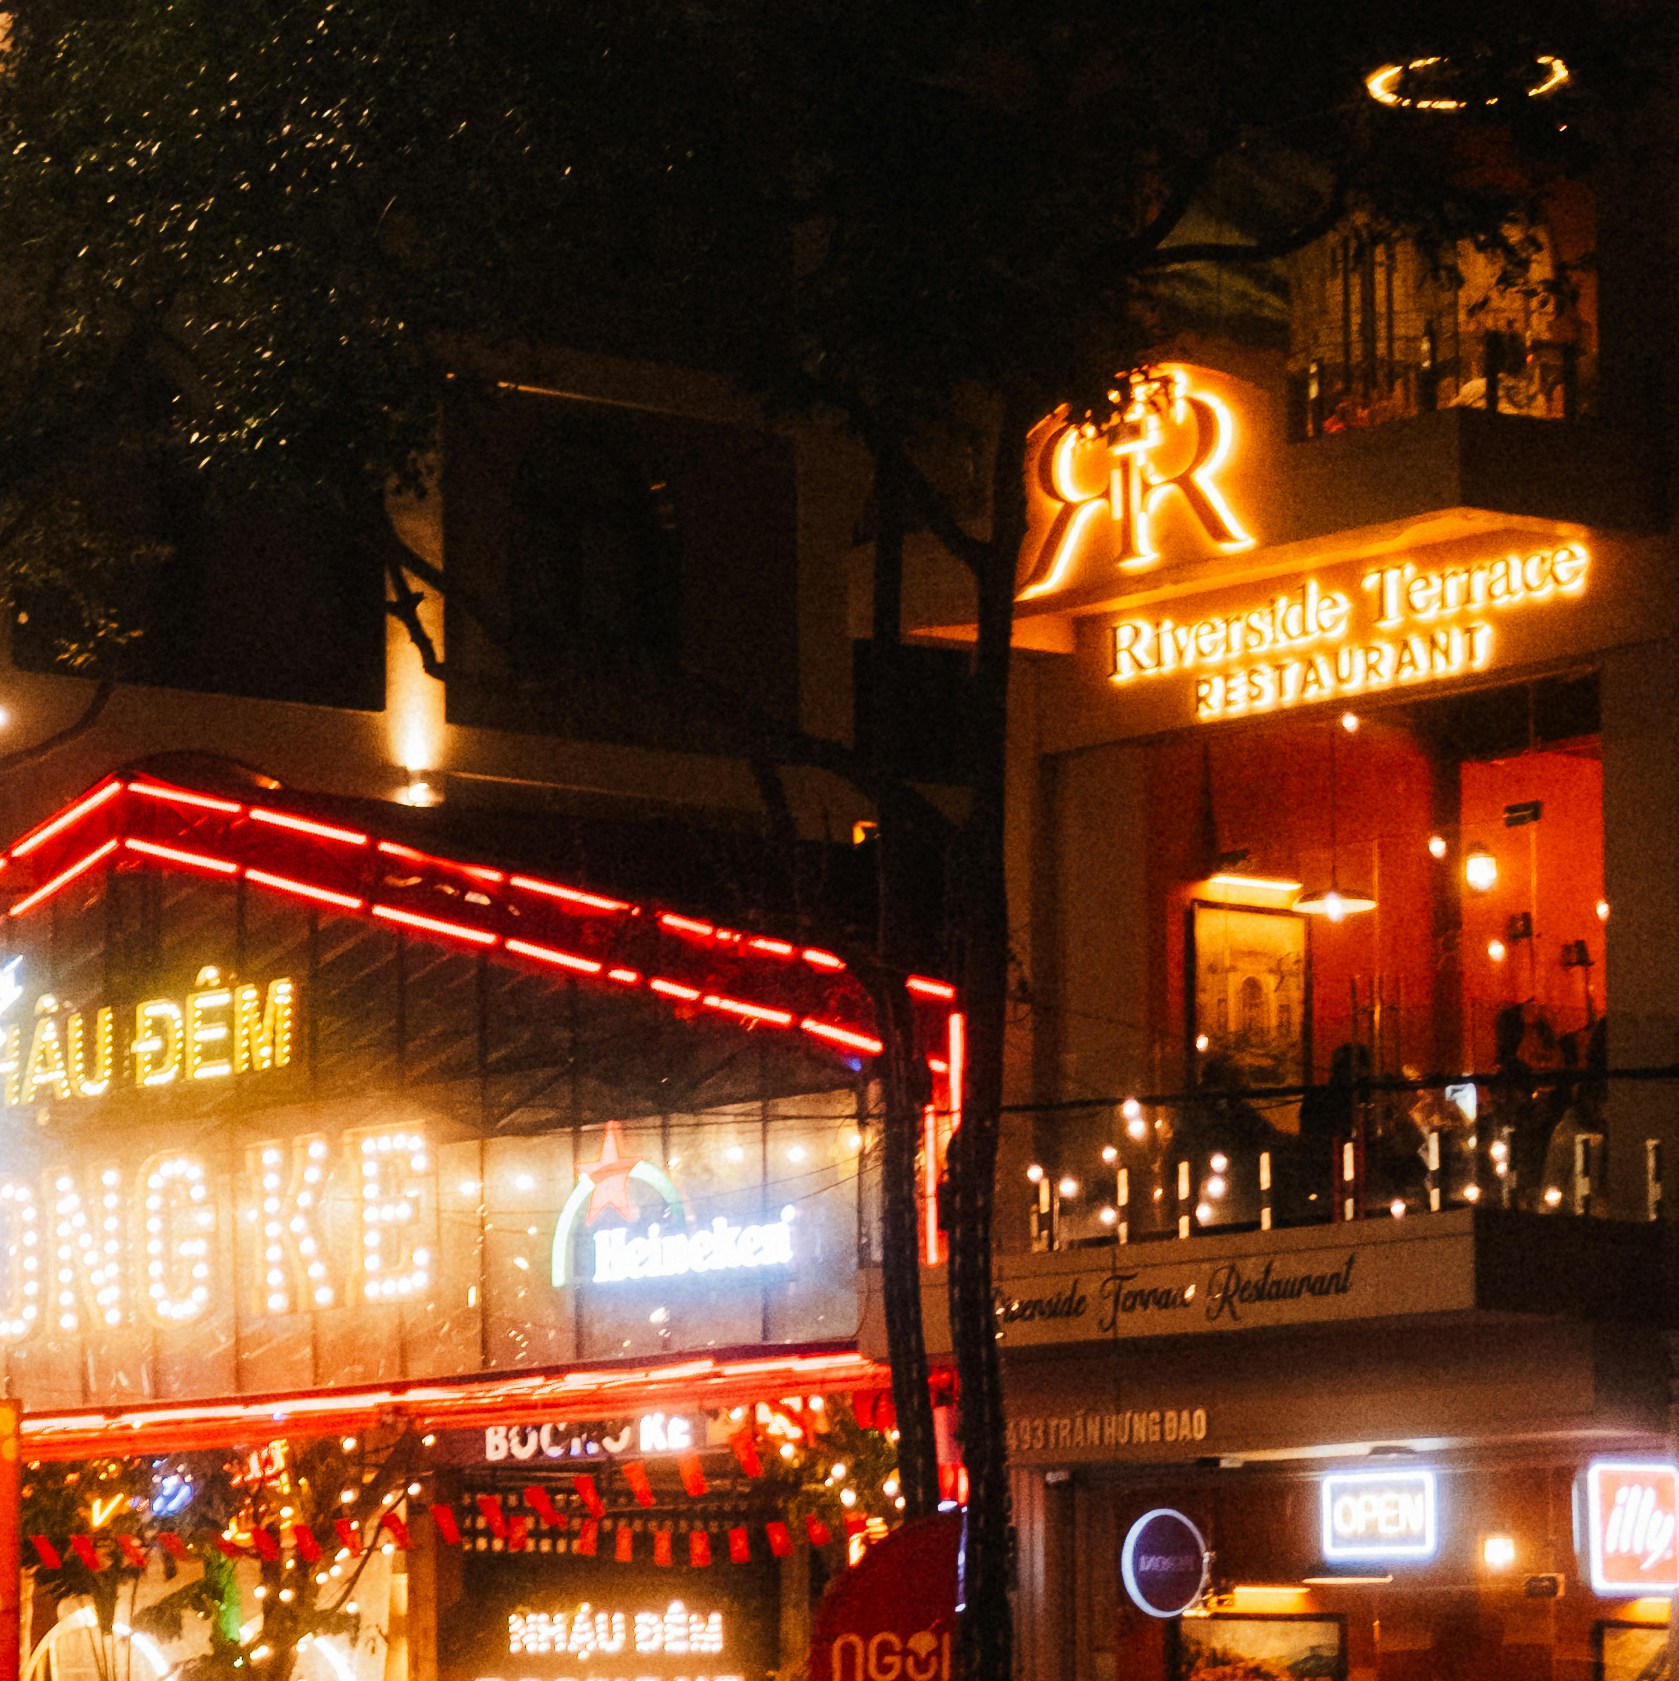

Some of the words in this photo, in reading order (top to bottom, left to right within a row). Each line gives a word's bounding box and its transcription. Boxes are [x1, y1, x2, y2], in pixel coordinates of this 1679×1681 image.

[1109, 578, 1350, 683] Riverside
[1362, 540, 1590, 629] Terrace
[1195, 621, 1492, 721] RESTAURANT
[130, 965, 293, 1089] ĐÊM
[246, 1119, 438, 1315] KE
[593, 1214, 794, 1283] Heineken
[1206, 1252, 1356, 1321] Restaurant
[1332, 1491, 1425, 1534] OPEN
[1605, 1483, 1675, 1570] illy
